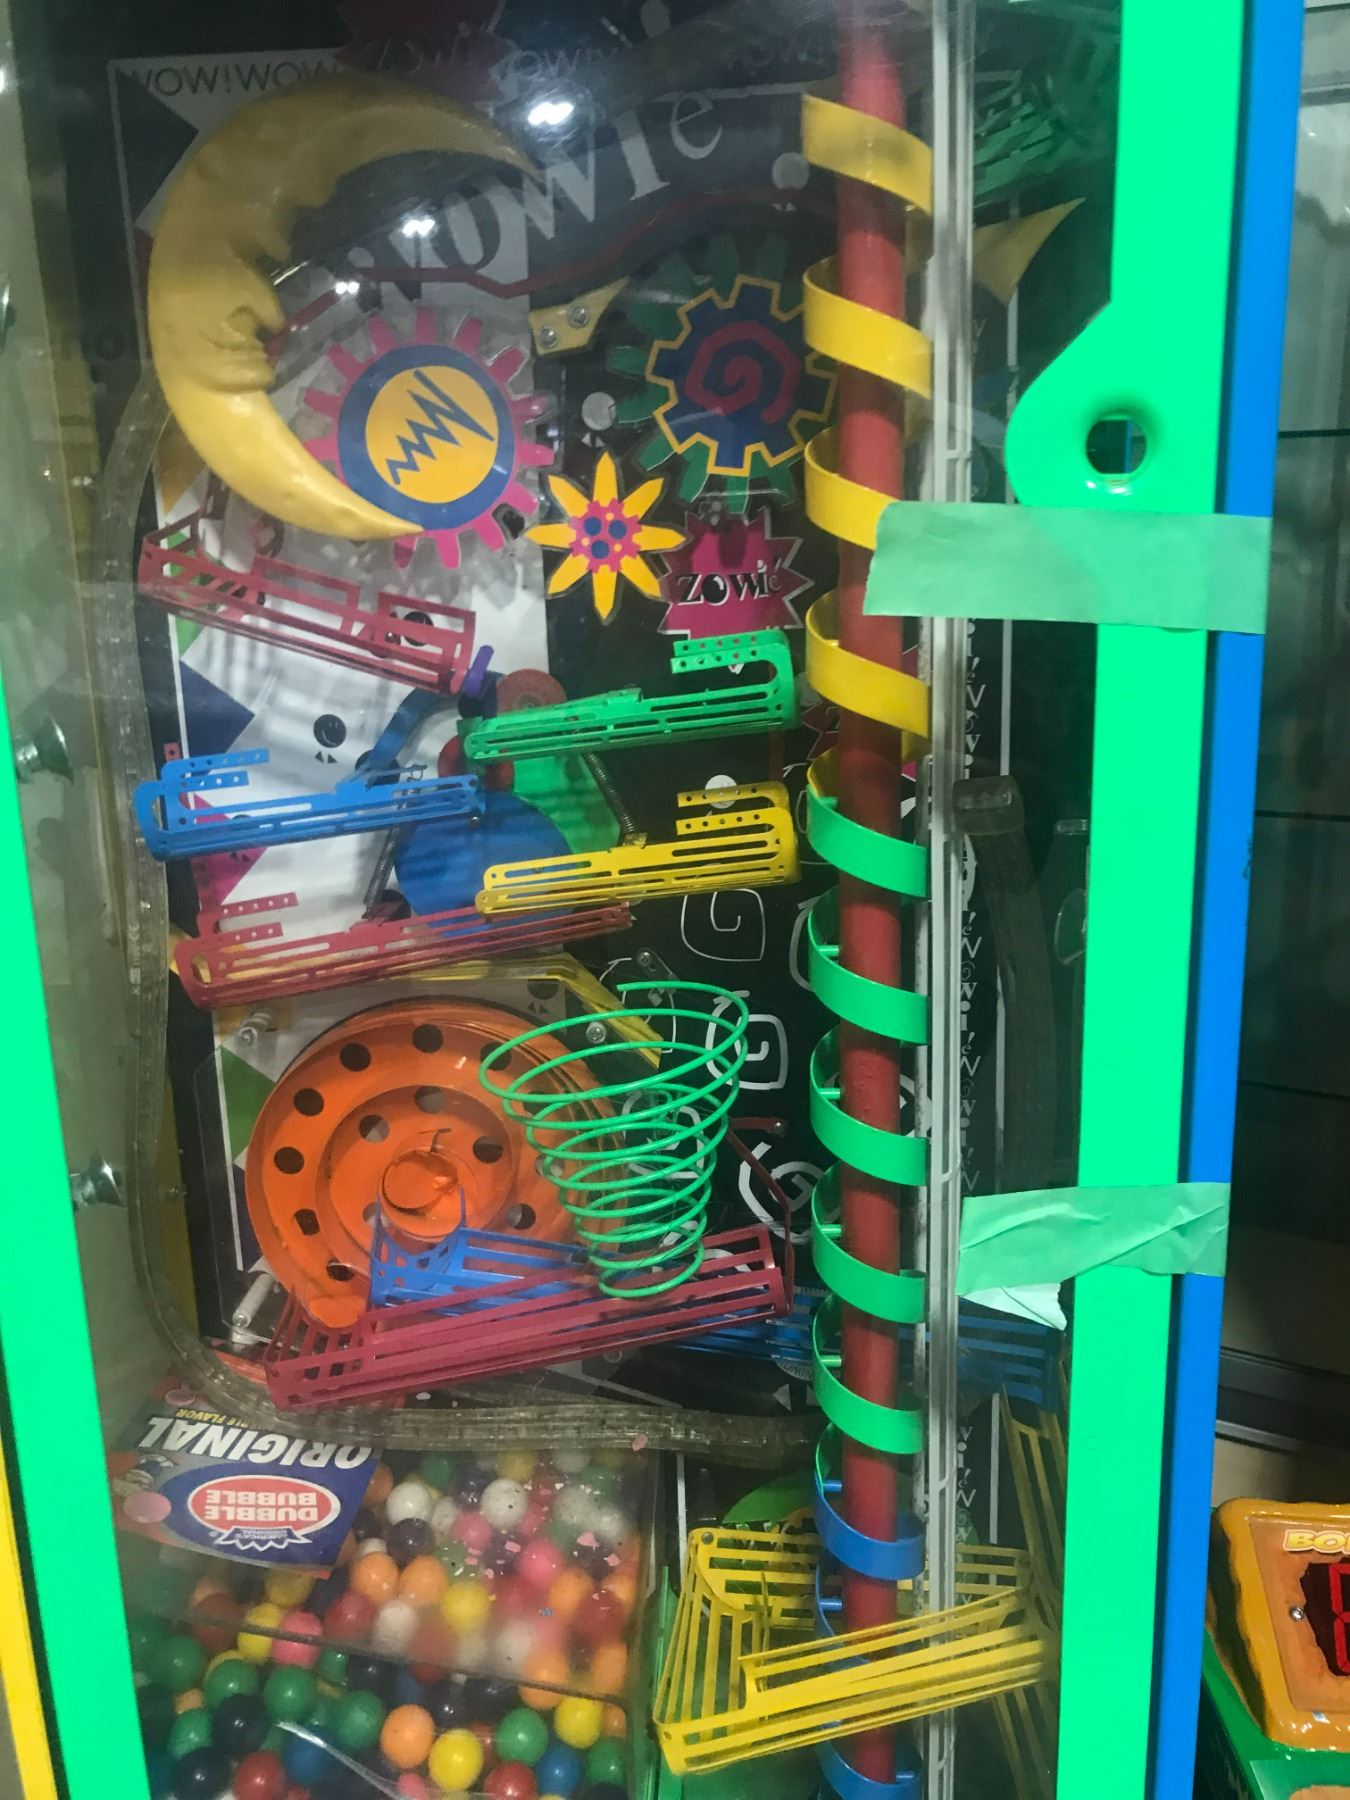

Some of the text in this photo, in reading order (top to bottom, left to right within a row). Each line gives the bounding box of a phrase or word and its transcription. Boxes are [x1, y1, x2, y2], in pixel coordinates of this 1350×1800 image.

[175, 1408, 225, 1424] FLAVOR
[138, 1416, 372, 1470] ORIGINAL
[206, 1489, 317, 1506] BUBBLE
[204, 1505, 319, 1522] DUBBLE
[1284, 1529, 1350, 1555] BO
